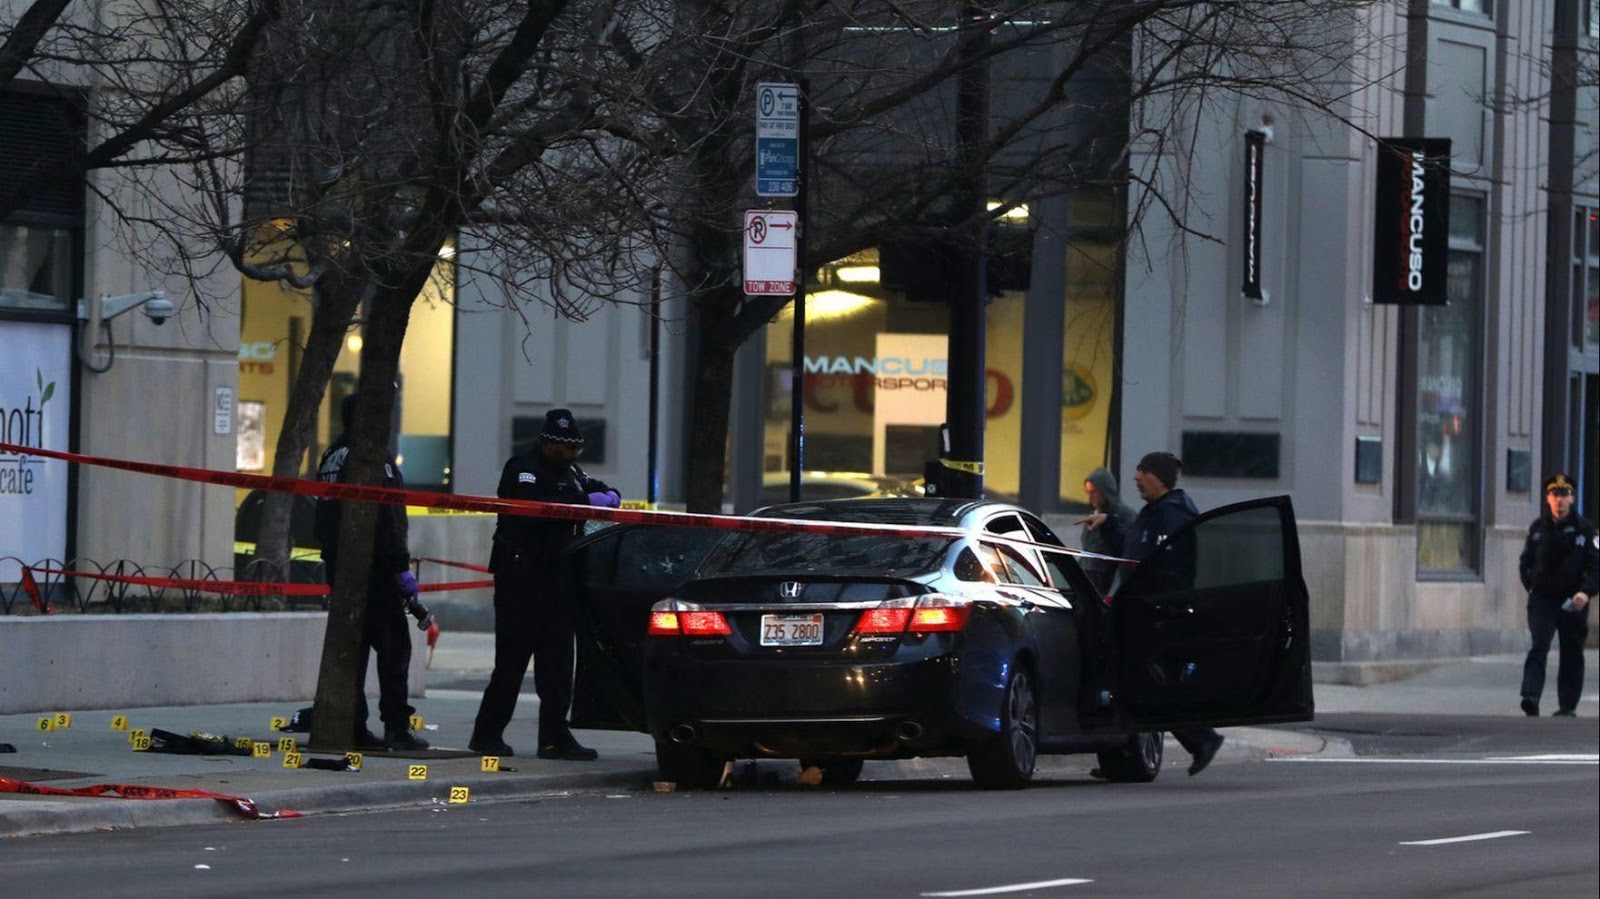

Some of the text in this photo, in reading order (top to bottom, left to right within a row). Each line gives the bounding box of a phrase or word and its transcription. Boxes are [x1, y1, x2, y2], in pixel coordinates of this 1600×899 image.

[1408, 151, 1424, 291] MANCUSO
[747, 281, 791, 292] TOW ZONE
[803, 355, 948, 376] MANCUS
[0, 455, 33, 494] cafe
[792, 624, 819, 640] 2800
[135, 738, 148, 748] 18
[281, 740, 291, 750] 15
[256, 744, 269, 754] 19
[286, 755, 298, 764] 21
[484, 758, 497, 768] 17
[411, 767, 425, 776] 22
[452, 790, 466, 800] 23
